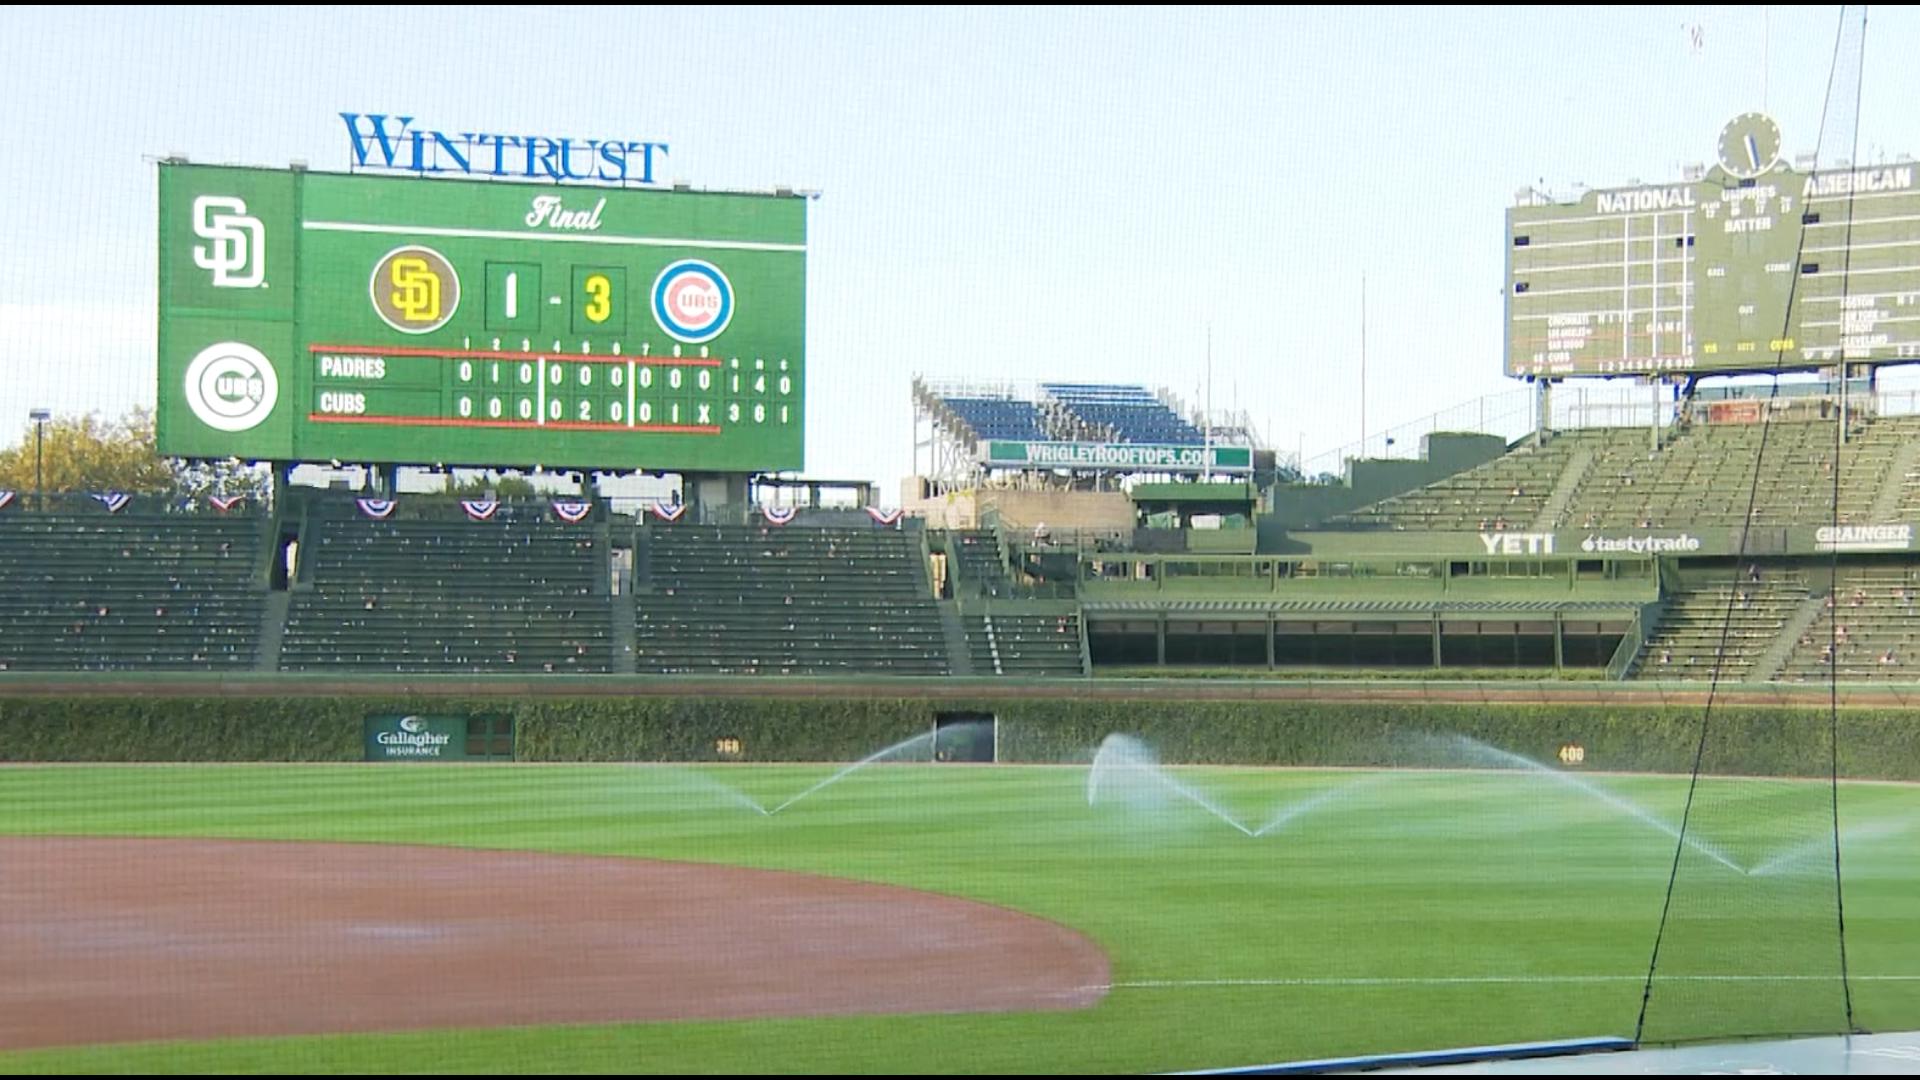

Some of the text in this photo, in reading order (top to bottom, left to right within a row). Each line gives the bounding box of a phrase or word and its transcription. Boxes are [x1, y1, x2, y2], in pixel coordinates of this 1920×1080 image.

[339, 112, 669, 183] WINTRUST
[1803, 168, 1911, 197] AMERICAN
[1596, 187, 1695, 214] NATIONAL
[525, 196, 606, 230] Final
[1724, 217, 1771, 232] BATTER
[506, 273, 517, 318] 1
[586, 275, 611, 323] 3
[464, 337, 470, 350] 1
[492, 338, 501, 351] 2
[553, 340, 561, 353] 4
[642, 343, 650, 356] 7
[321, 356, 791, 395] PADRES 0 1 0 0 0 0 0 0 0 1 4 0
[321, 391, 788, 425] CUBS 0 0 0 0 2 0 0 1 X 3 6 1
[1025, 443, 1217, 465] WRIGLEYROOFTOPS.COM
[1480, 533, 1555, 555] YETI
[1595, 534, 1699, 553] tastytrade
[1815, 526, 1911, 543] GRAINGER
[377, 731, 449, 750] Gallagher
